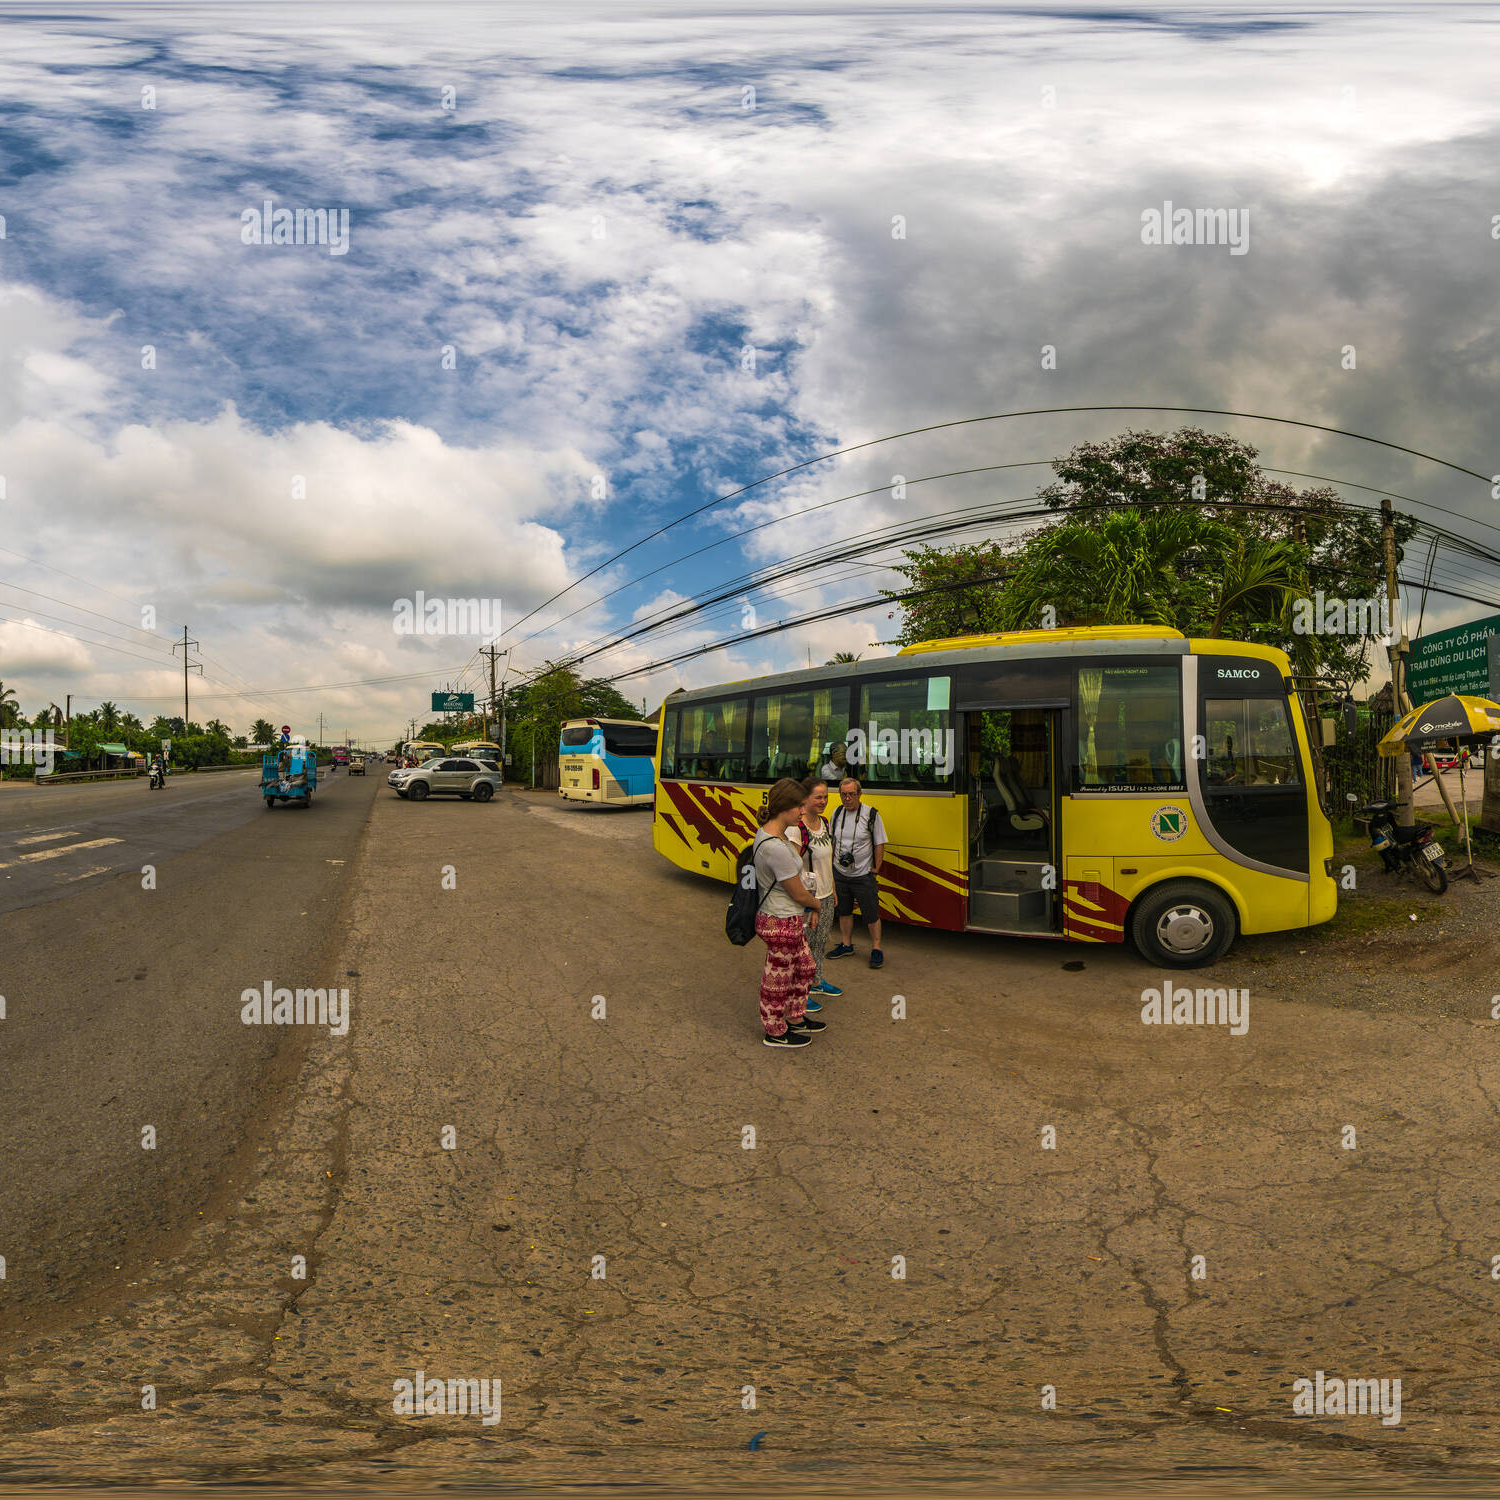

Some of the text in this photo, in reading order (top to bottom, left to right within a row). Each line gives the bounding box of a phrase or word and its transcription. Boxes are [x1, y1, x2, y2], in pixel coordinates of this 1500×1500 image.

[1422, 641, 1443, 655] CÔNG
[1445, 638, 1455, 649] TY
[1456, 630, 1469, 646] CỔ
[1410, 659, 1429, 672] TRẠM
[1453, 651, 1464, 662] DU
[1466, 646, 1486, 660] LỊCH
[1217, 669, 1260, 679] SAMCO
[1434, 720, 1463, 729] mobile
[762, 791, 768, 805] 5
